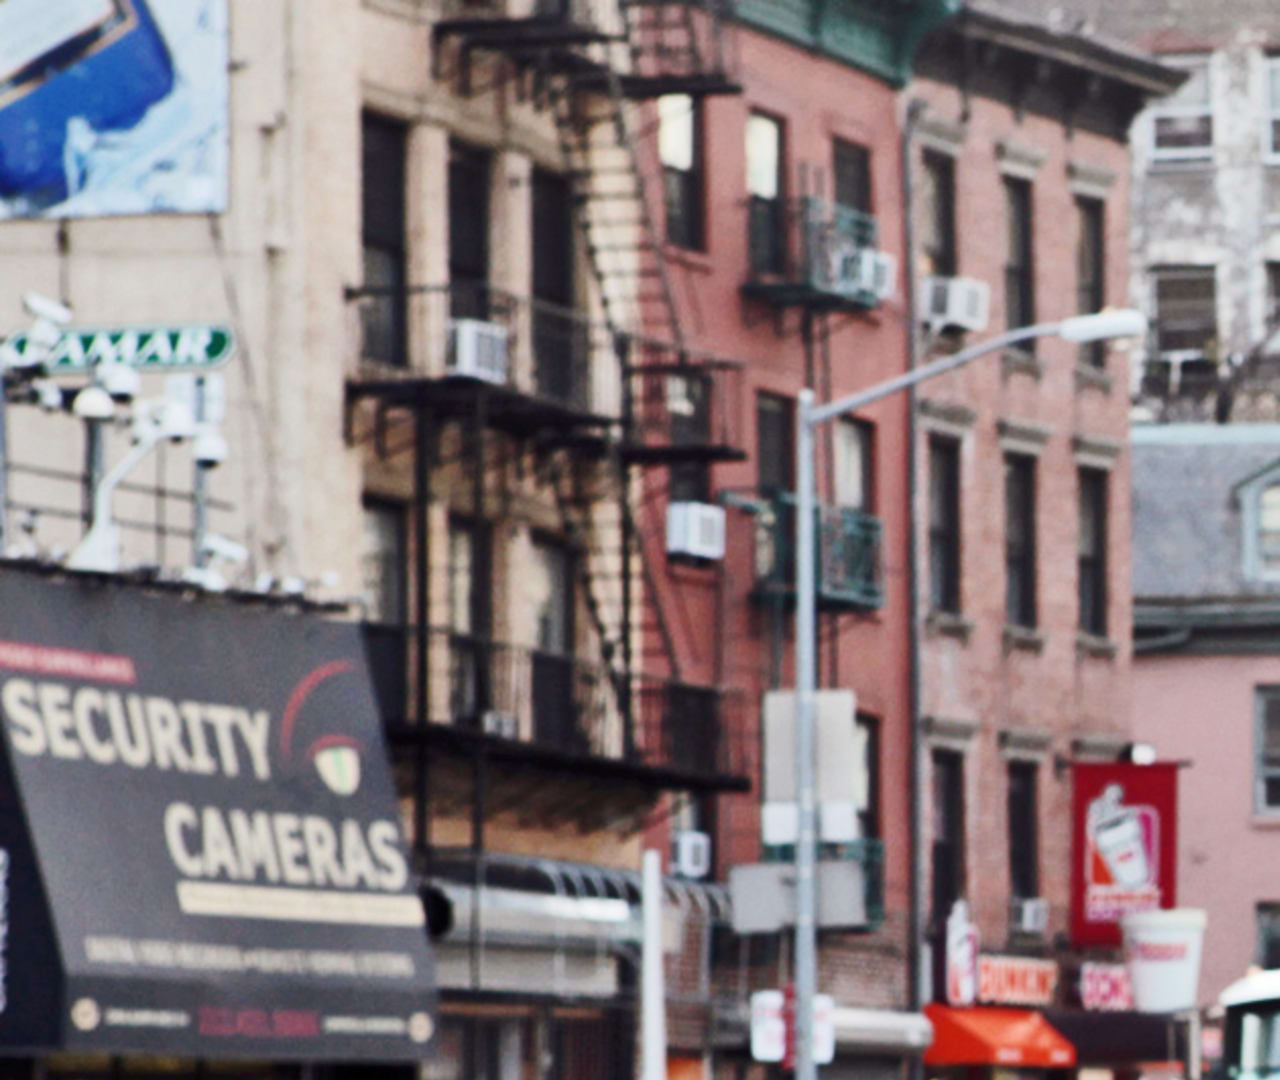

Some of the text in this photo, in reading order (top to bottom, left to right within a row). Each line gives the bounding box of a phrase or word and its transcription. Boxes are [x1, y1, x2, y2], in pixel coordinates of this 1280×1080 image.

[24, 327, 213, 367] AMAR
[1, 678, 271, 781] SECURITY
[163, 801, 408, 891] CAMERAS
